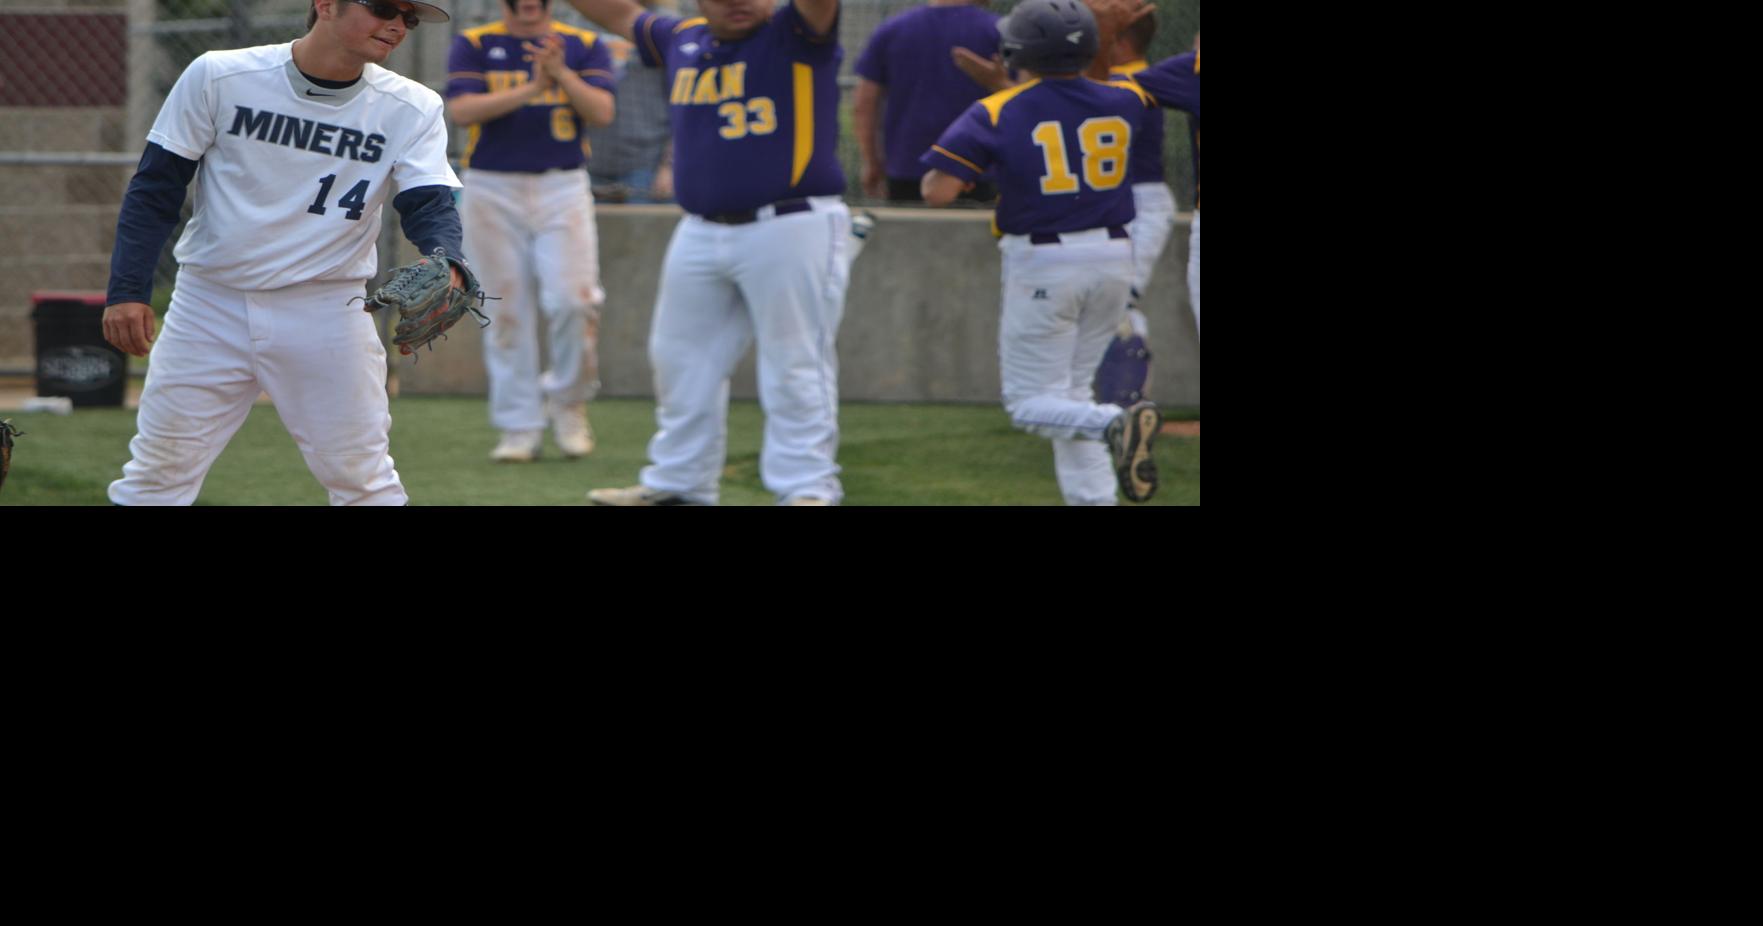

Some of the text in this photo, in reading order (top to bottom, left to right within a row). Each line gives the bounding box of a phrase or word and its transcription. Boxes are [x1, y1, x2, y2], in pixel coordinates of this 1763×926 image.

[226, 104, 387, 164] MINERS
[717, 96, 778, 140] 33
[1030, 115, 1132, 196] 18
[306, 172, 371, 221] 14
